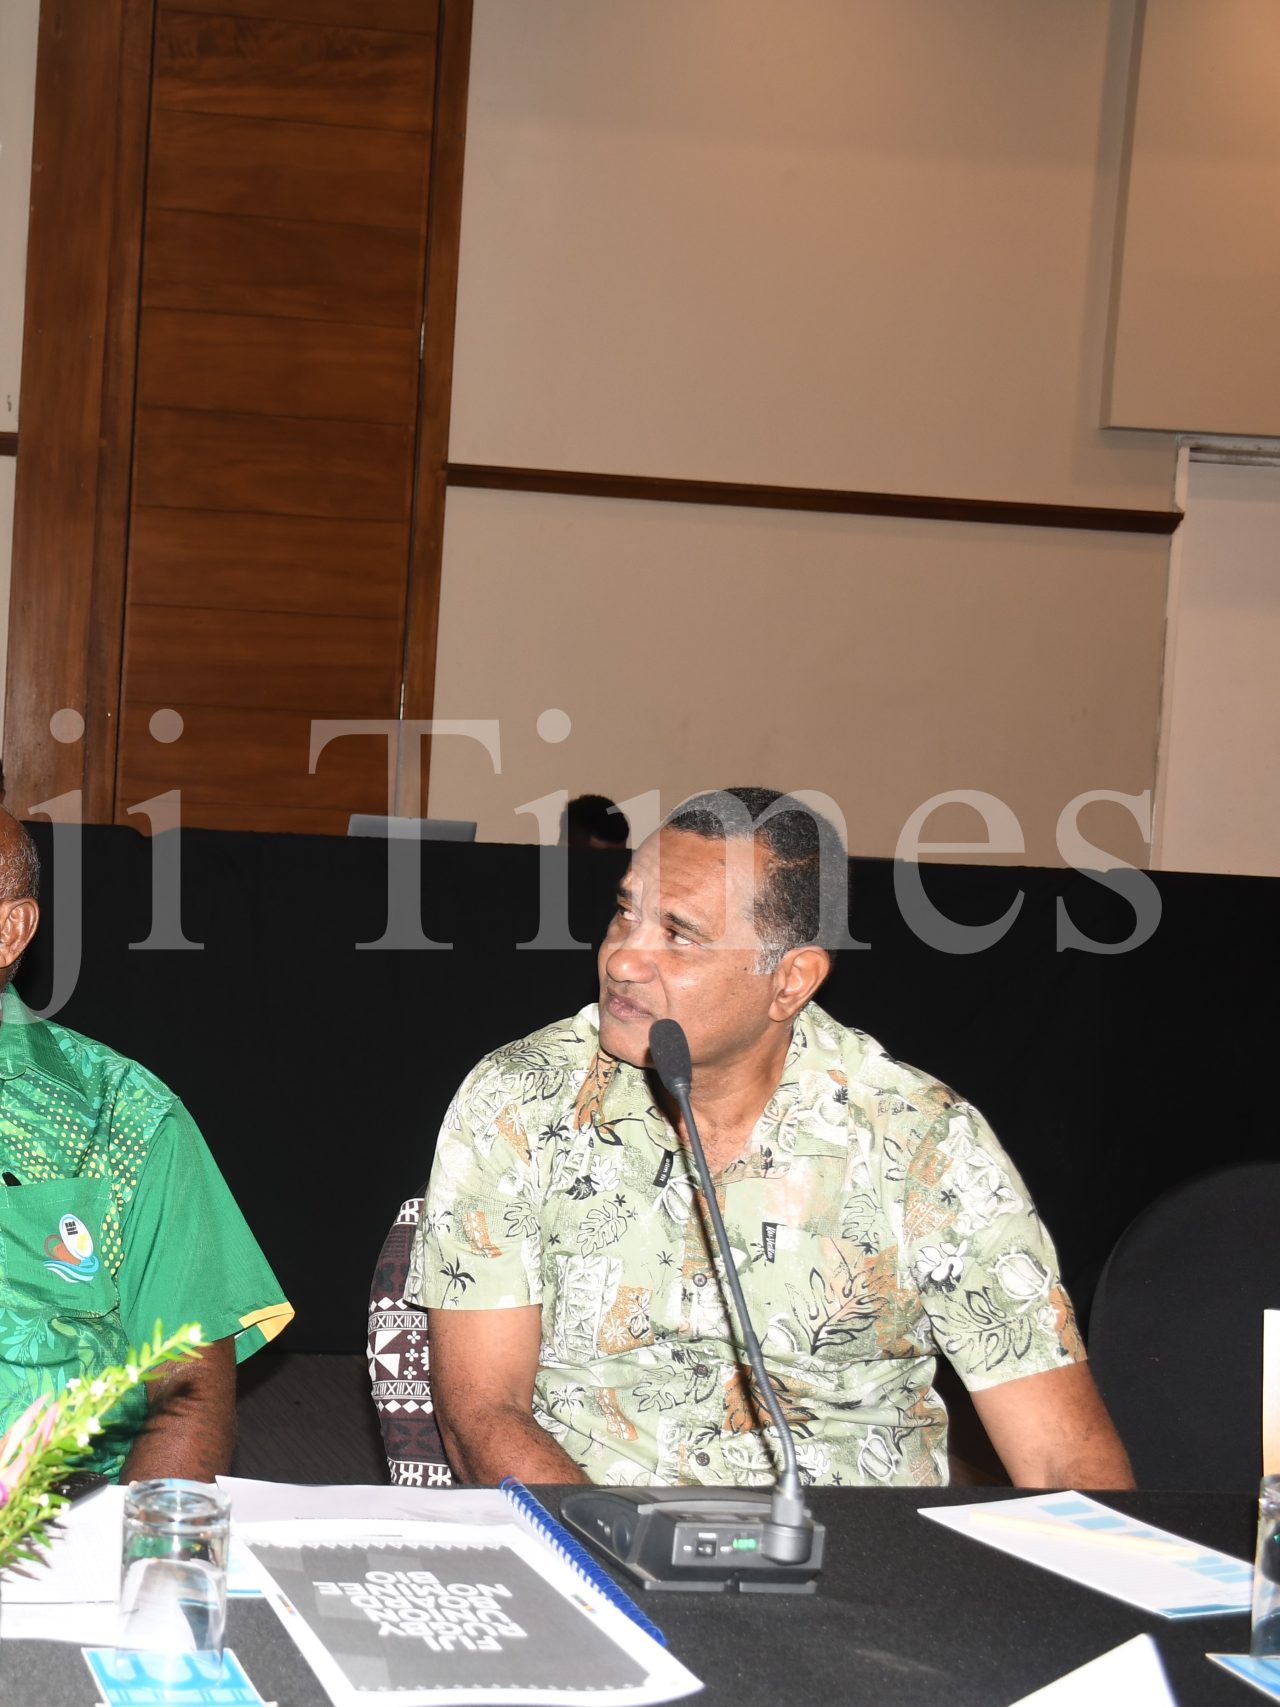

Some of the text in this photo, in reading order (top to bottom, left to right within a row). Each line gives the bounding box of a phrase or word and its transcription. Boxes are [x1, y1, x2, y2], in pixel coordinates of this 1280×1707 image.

[365, 1571, 442, 1585] BIO
[312, 1581, 513, 1597] NOMINEE
[350, 1595, 502, 1610] BOARD
[363, 1608, 513, 1623] UNION
[378, 1621, 528, 1637] RUGBY
[422, 1635, 503, 1651] FIJI
